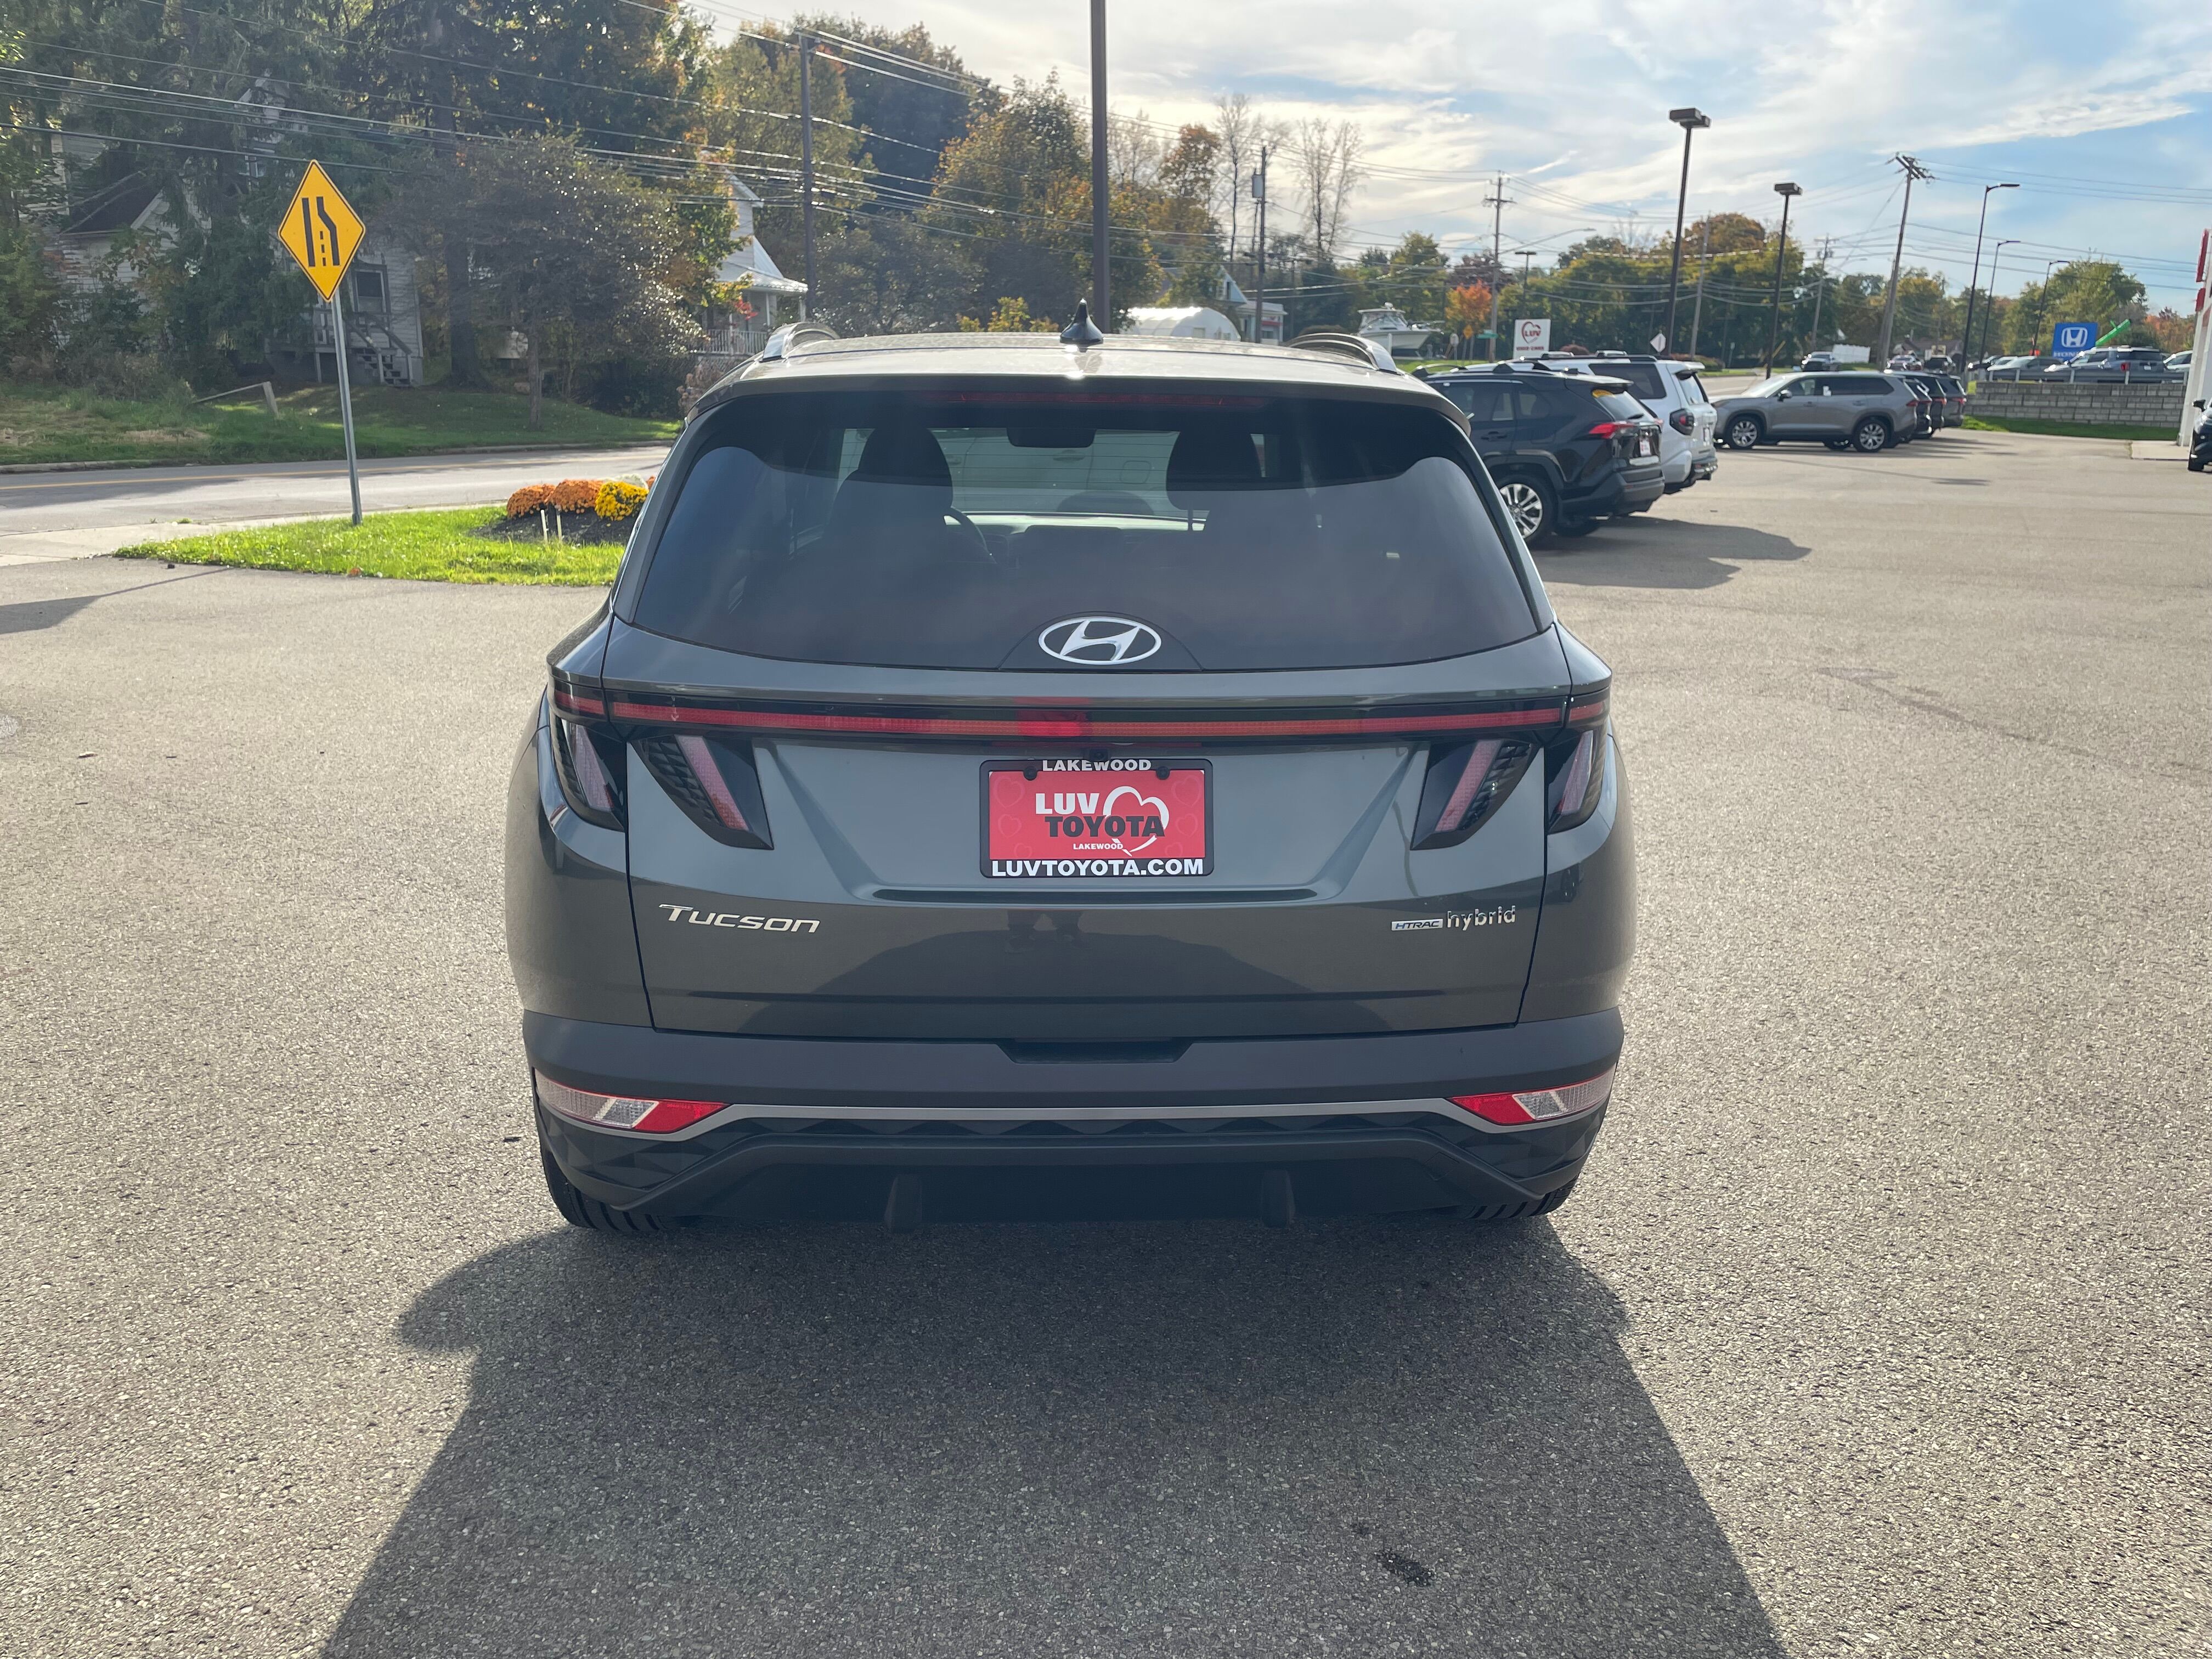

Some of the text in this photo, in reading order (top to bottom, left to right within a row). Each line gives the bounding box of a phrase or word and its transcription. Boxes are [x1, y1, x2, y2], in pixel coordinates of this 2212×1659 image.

[1042, 759, 1152, 771] LAKEWOOD
[1035, 793, 1100, 814] LUV
[1045, 816, 1165, 837] TOYOTA
[992, 859, 1204, 876] LUVTOYOTA.COM
[1395, 905, 1516, 931] HTRAC hybrid
